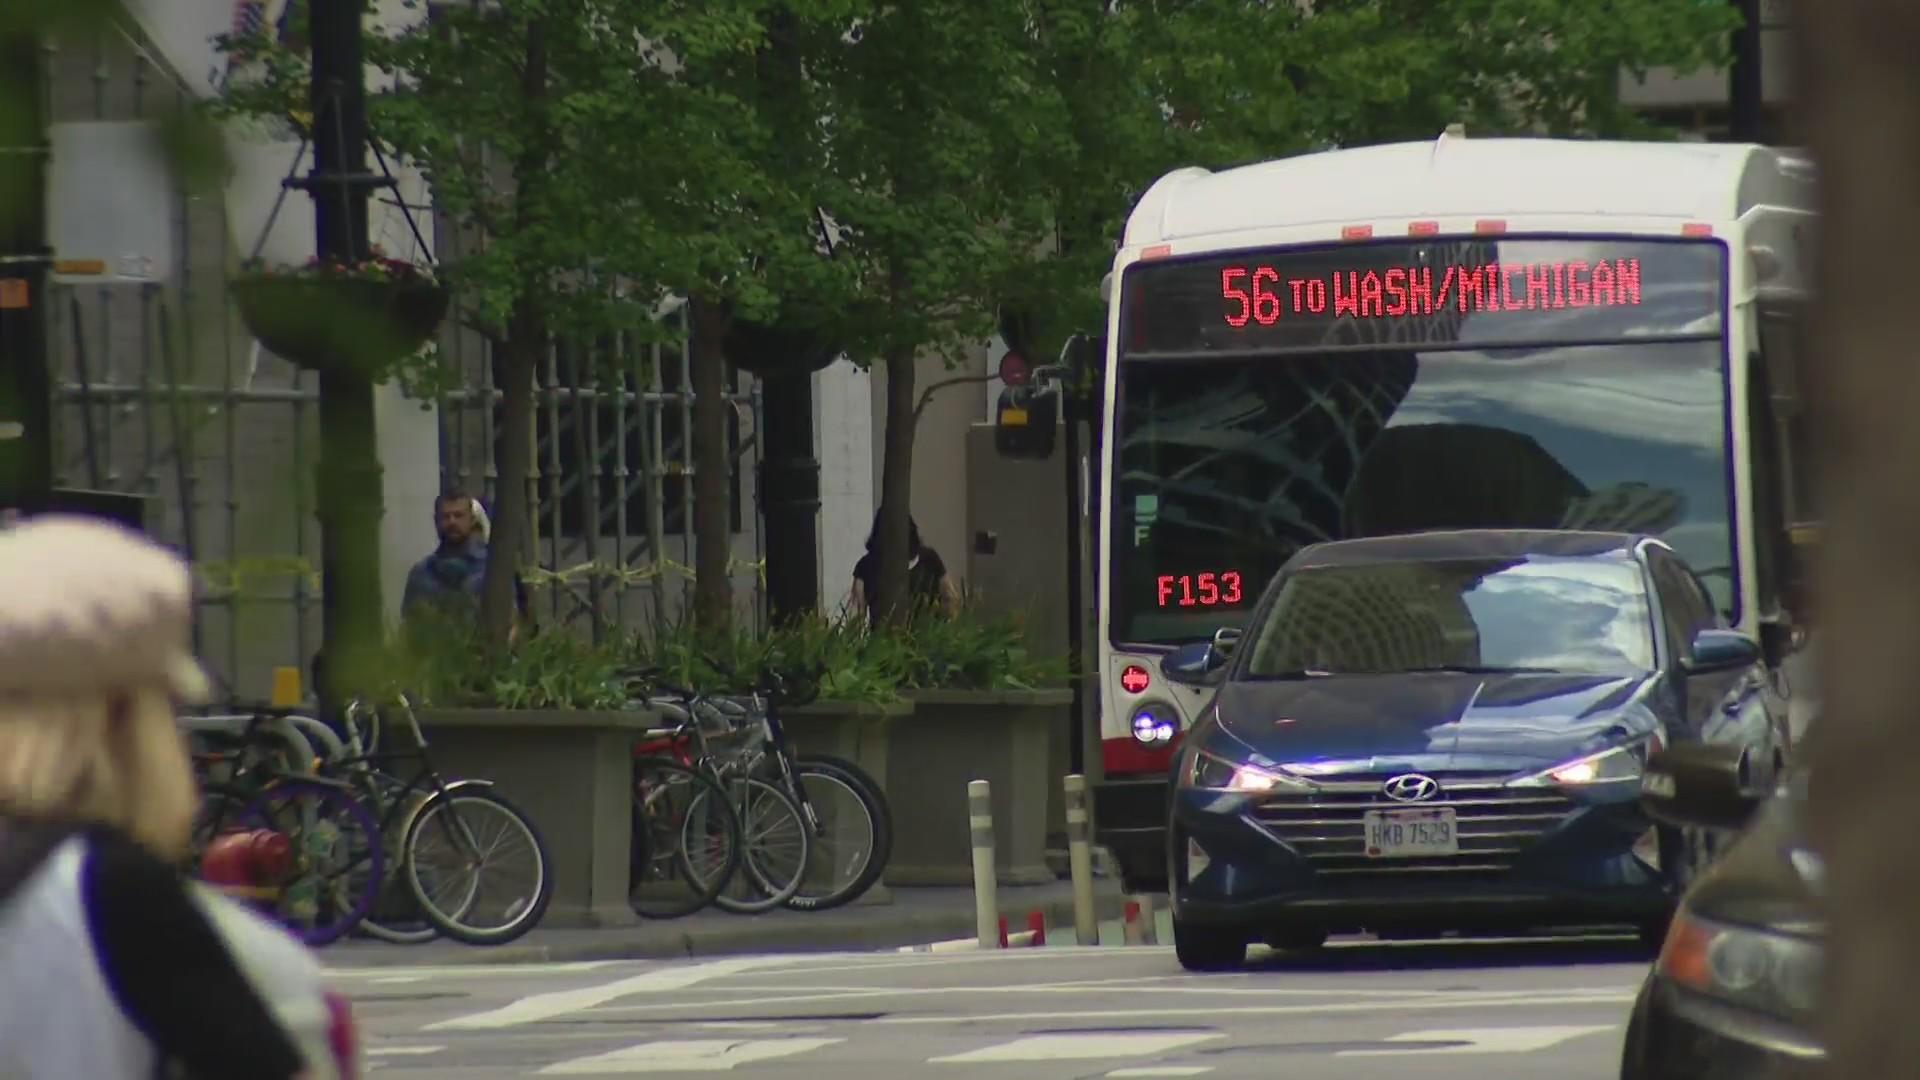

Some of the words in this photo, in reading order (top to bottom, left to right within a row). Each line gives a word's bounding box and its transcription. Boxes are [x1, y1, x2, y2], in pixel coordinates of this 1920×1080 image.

[1221, 267, 1279, 327] 56
[1289, 278, 1327, 312] TO
[1333, 259, 1642, 318] WASH/MICHIGAN
[1157, 570, 1242, 606] F153
